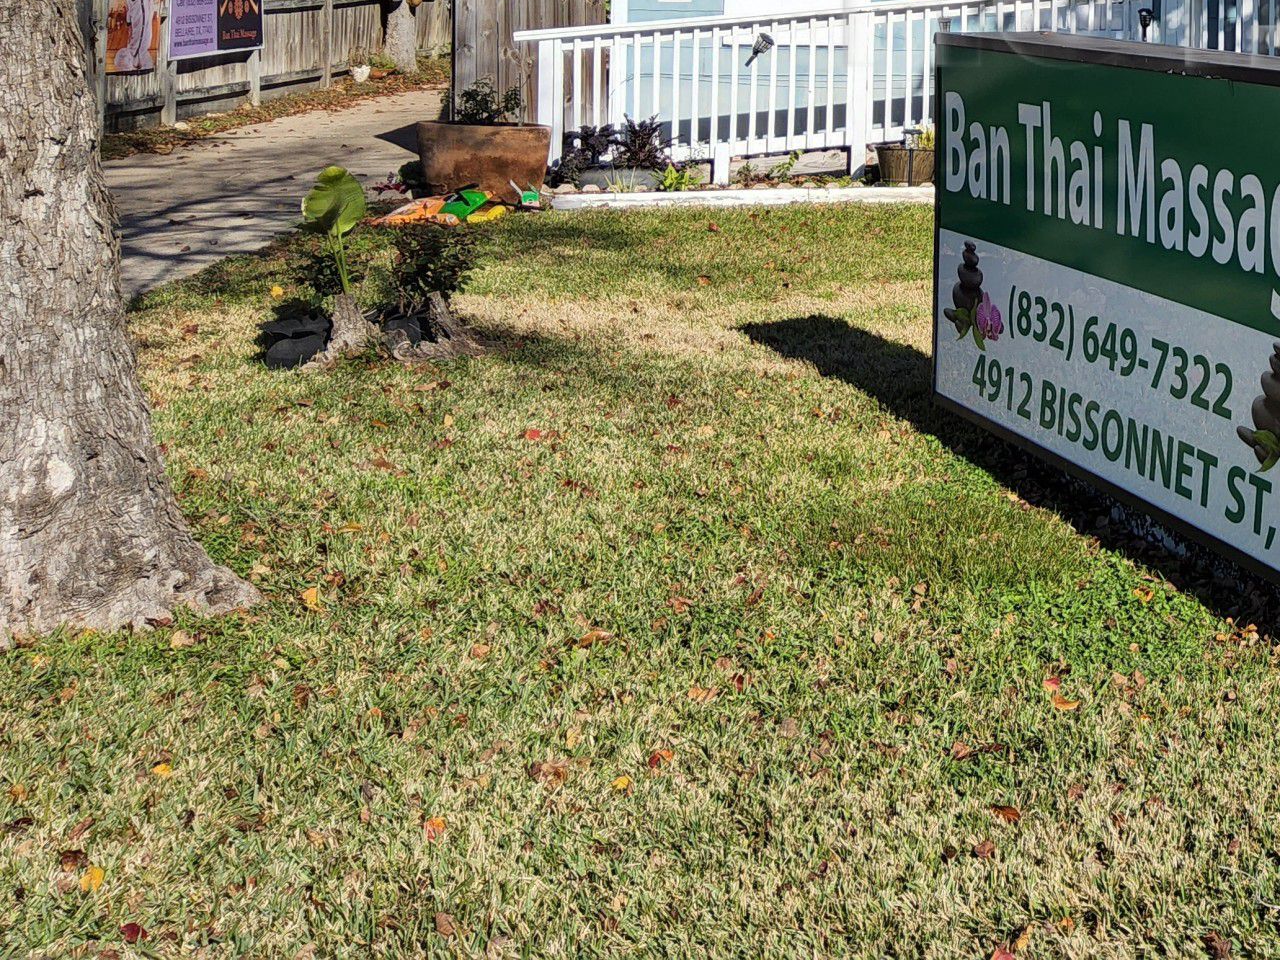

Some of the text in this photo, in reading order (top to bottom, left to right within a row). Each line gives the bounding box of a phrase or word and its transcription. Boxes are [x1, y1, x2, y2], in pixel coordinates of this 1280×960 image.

[944, 90, 1011, 206] Ban
[1017, 100, 1104, 230] Thai
[1008, 285, 1233, 420] (832) 649-7322
[972, 354, 1277, 550] 4912 BISSONNET ST,
